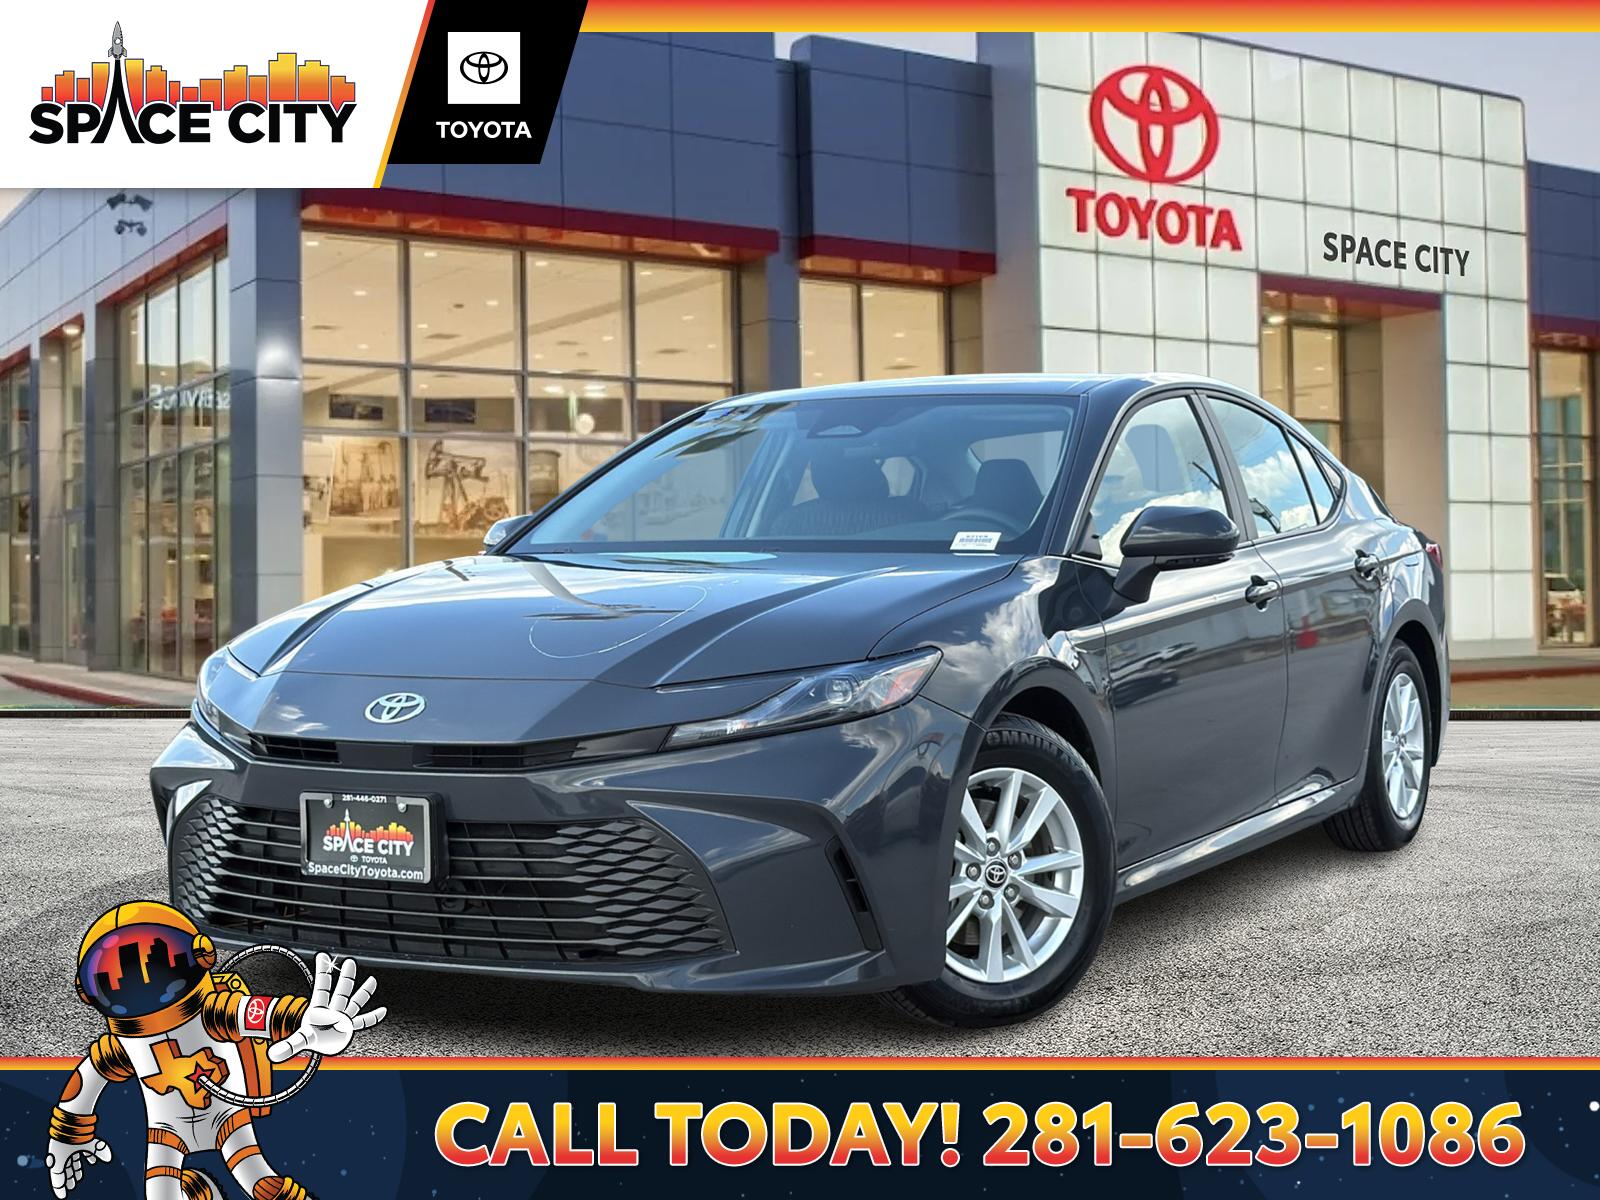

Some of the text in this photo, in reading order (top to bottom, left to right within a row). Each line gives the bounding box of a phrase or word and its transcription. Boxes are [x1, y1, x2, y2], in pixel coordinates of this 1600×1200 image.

[1066, 187, 1242, 251] TOYOTA
[1323, 232, 1470, 276] SPACE CITY
[377, 840, 414, 857] CITY
[361, 855, 388, 865] TOYOTA
[308, 861, 424, 880] SpaceCityToyota.com
